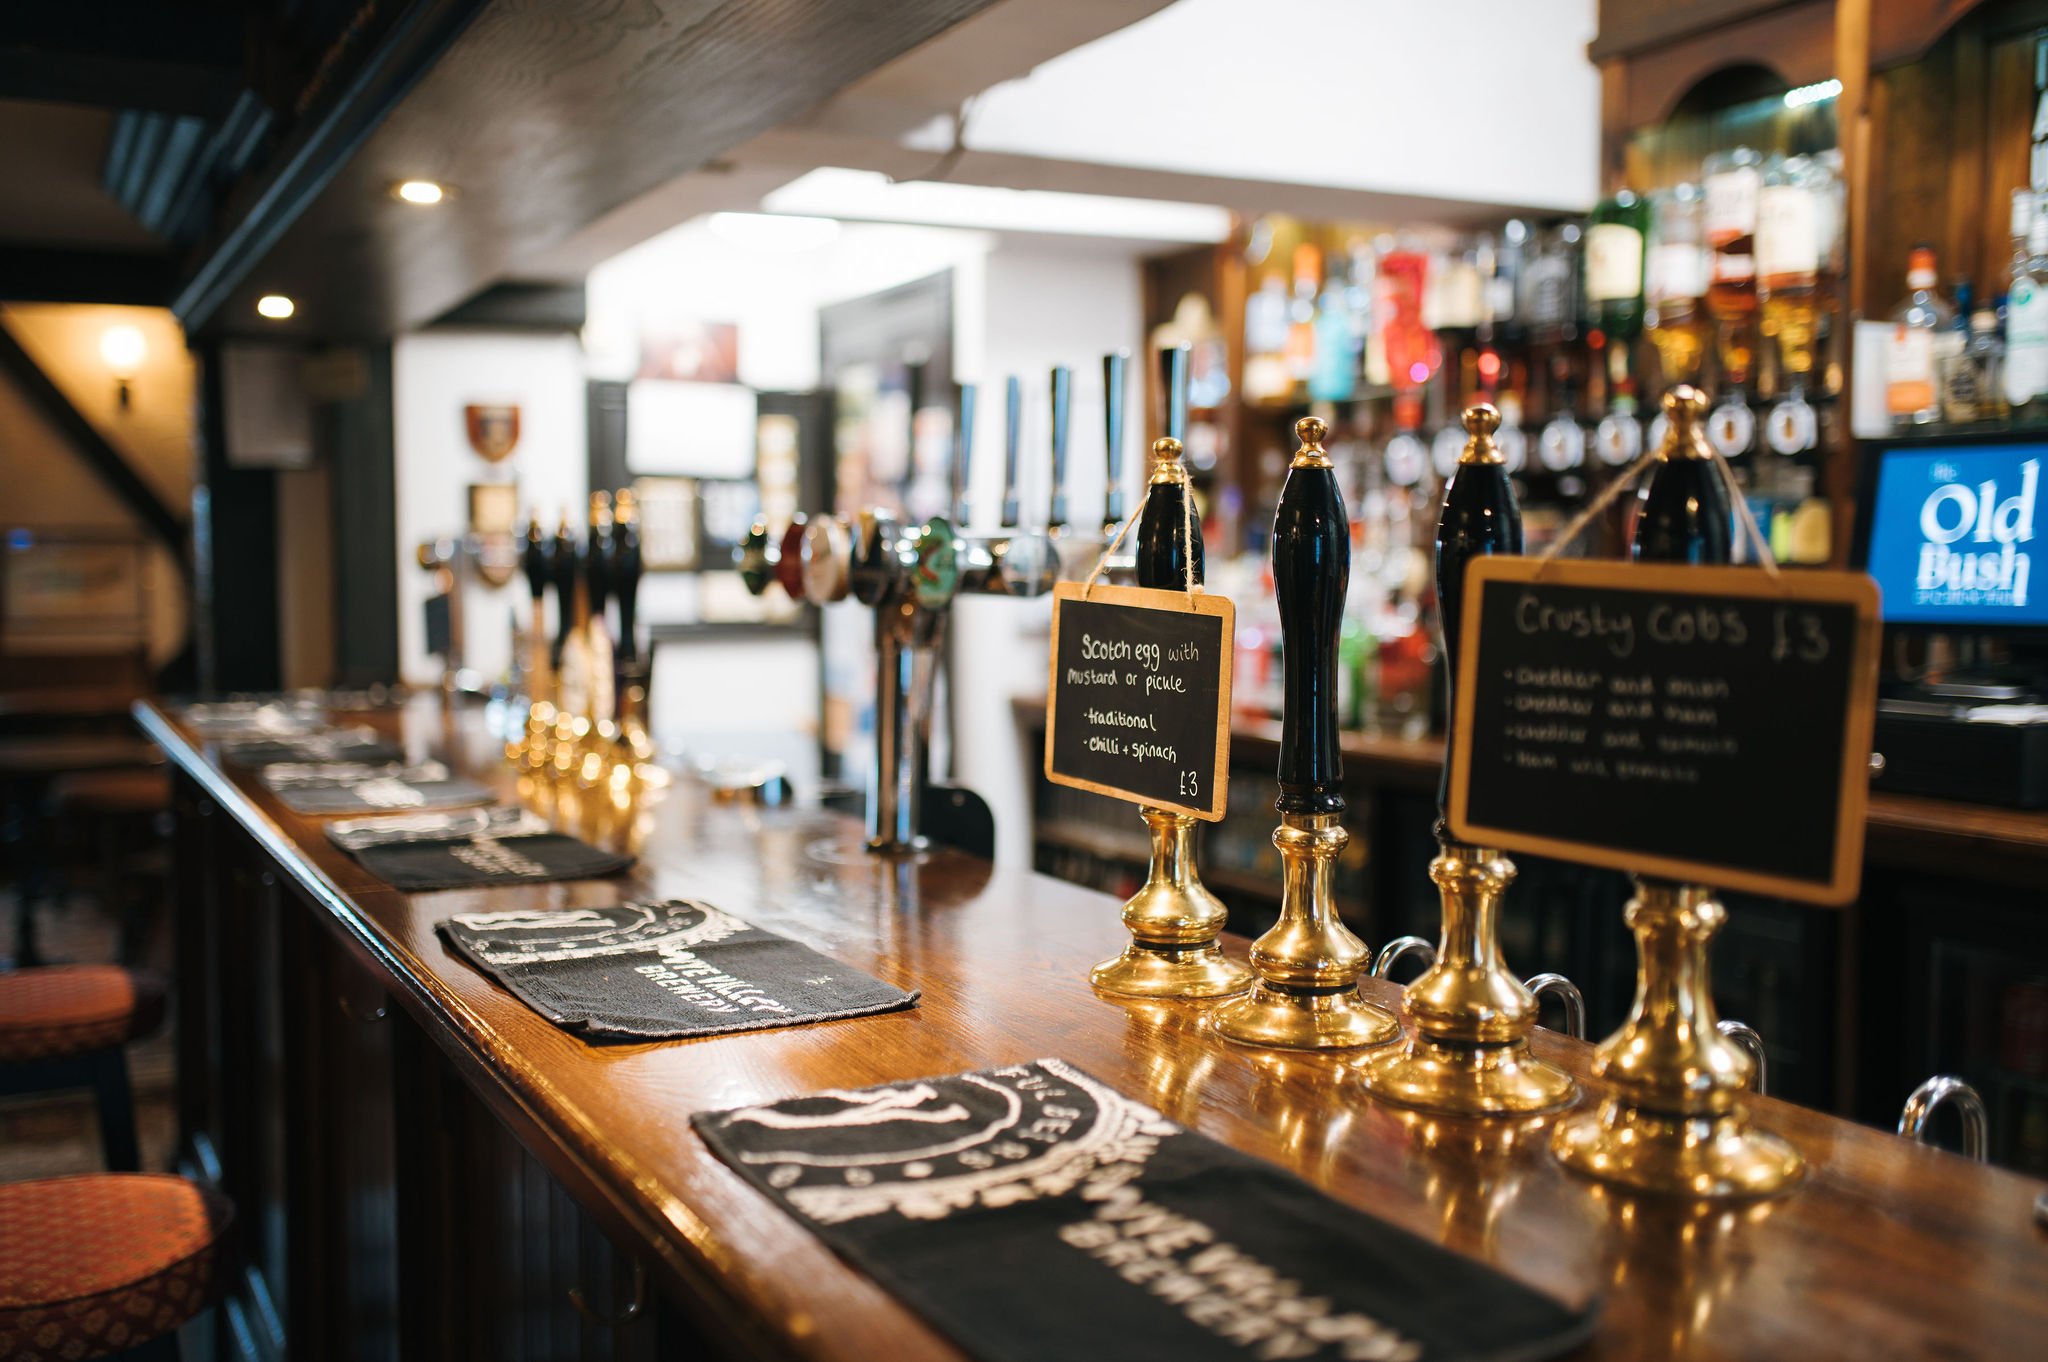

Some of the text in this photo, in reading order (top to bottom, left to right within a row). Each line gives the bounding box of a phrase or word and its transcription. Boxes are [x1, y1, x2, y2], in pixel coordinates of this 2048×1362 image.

[1919, 458, 2040, 545] Old
[1916, 542, 2031, 607] Bush
[1515, 593, 1636, 658] Crusty
[1646, 603, 1748, 646] Cobs
[1081, 633, 1199, 672] Scotch egg with
[1126, 673, 1138, 686] or
[1146, 675, 1187, 697] pickle
[1088, 708, 1157, 732] traditional
[1132, 743, 1177, 764] spinach
[1180, 770, 1198, 797] £3
